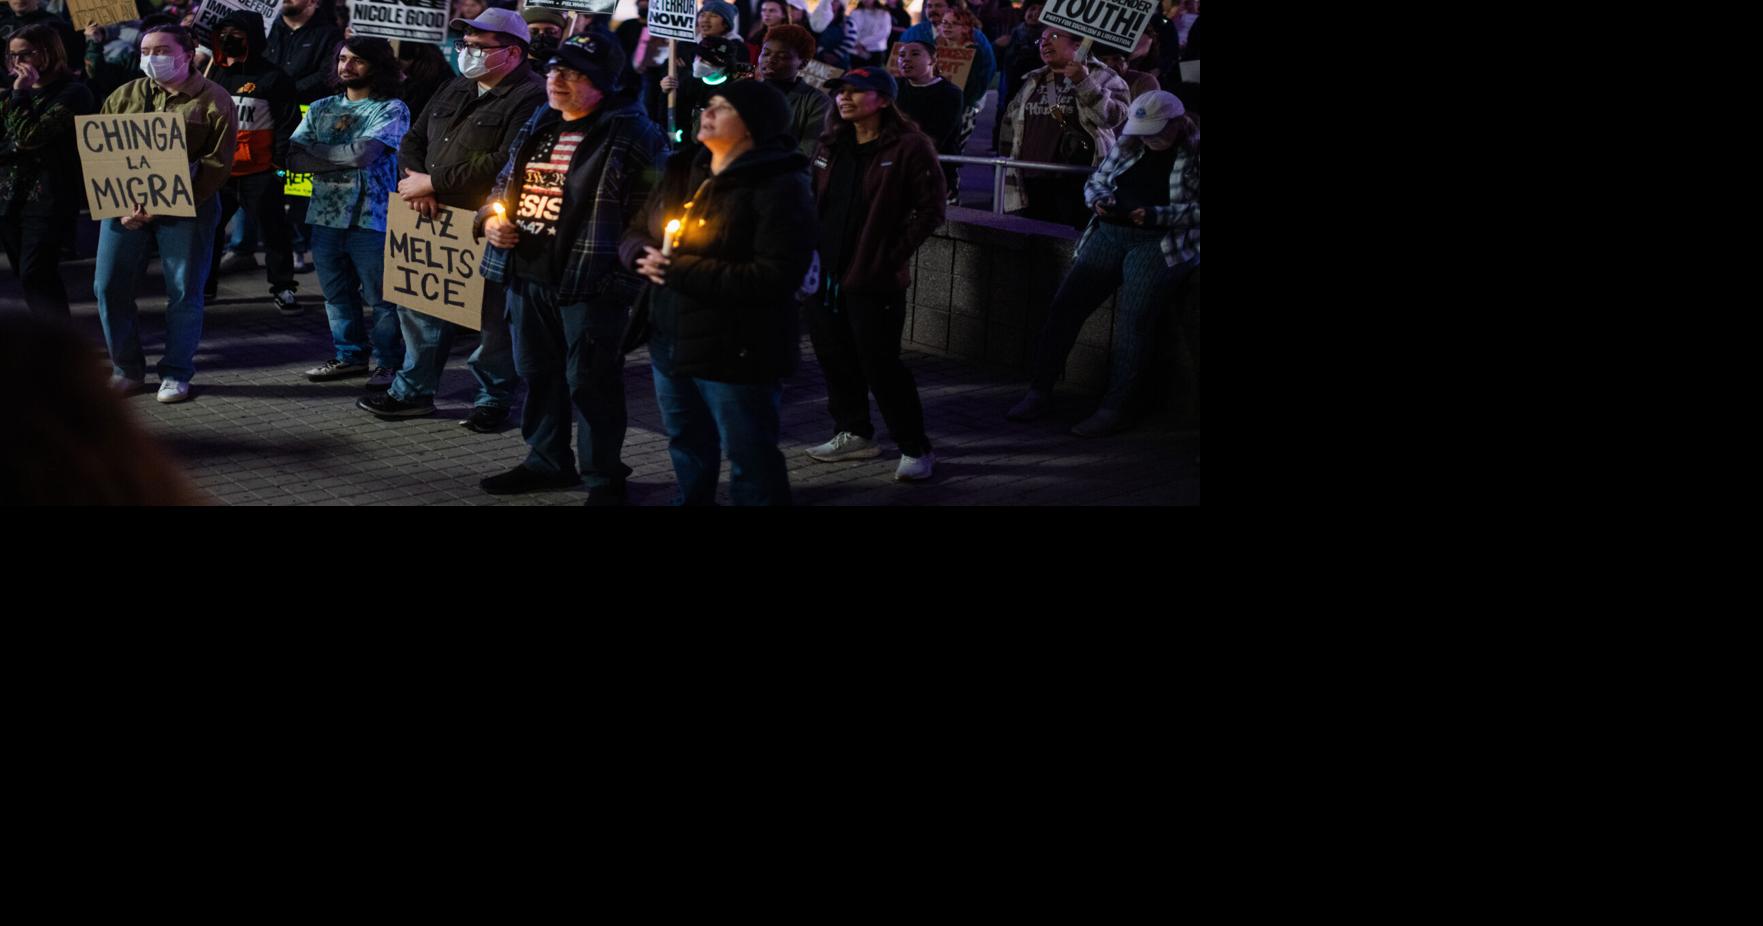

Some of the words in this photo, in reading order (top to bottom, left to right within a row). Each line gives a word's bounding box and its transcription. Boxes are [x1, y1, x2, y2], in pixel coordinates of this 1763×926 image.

[353, 4, 403, 24] NICOLE
[406, 9, 445, 28] GOOD
[649, 11, 694, 29] NOW!
[1045, 14, 1062, 23] PARTY
[1052, 0, 1147, 39] YOUTH!
[1111, 0, 1152, 13] ENDER
[83, 117, 186, 152] CHINGA
[127, 156, 150, 170] LA
[91, 174, 193, 209] MIGRA
[415, 207, 458, 240] AZ
[390, 229, 475, 278] MELTS
[394, 265, 466, 308] ICE
